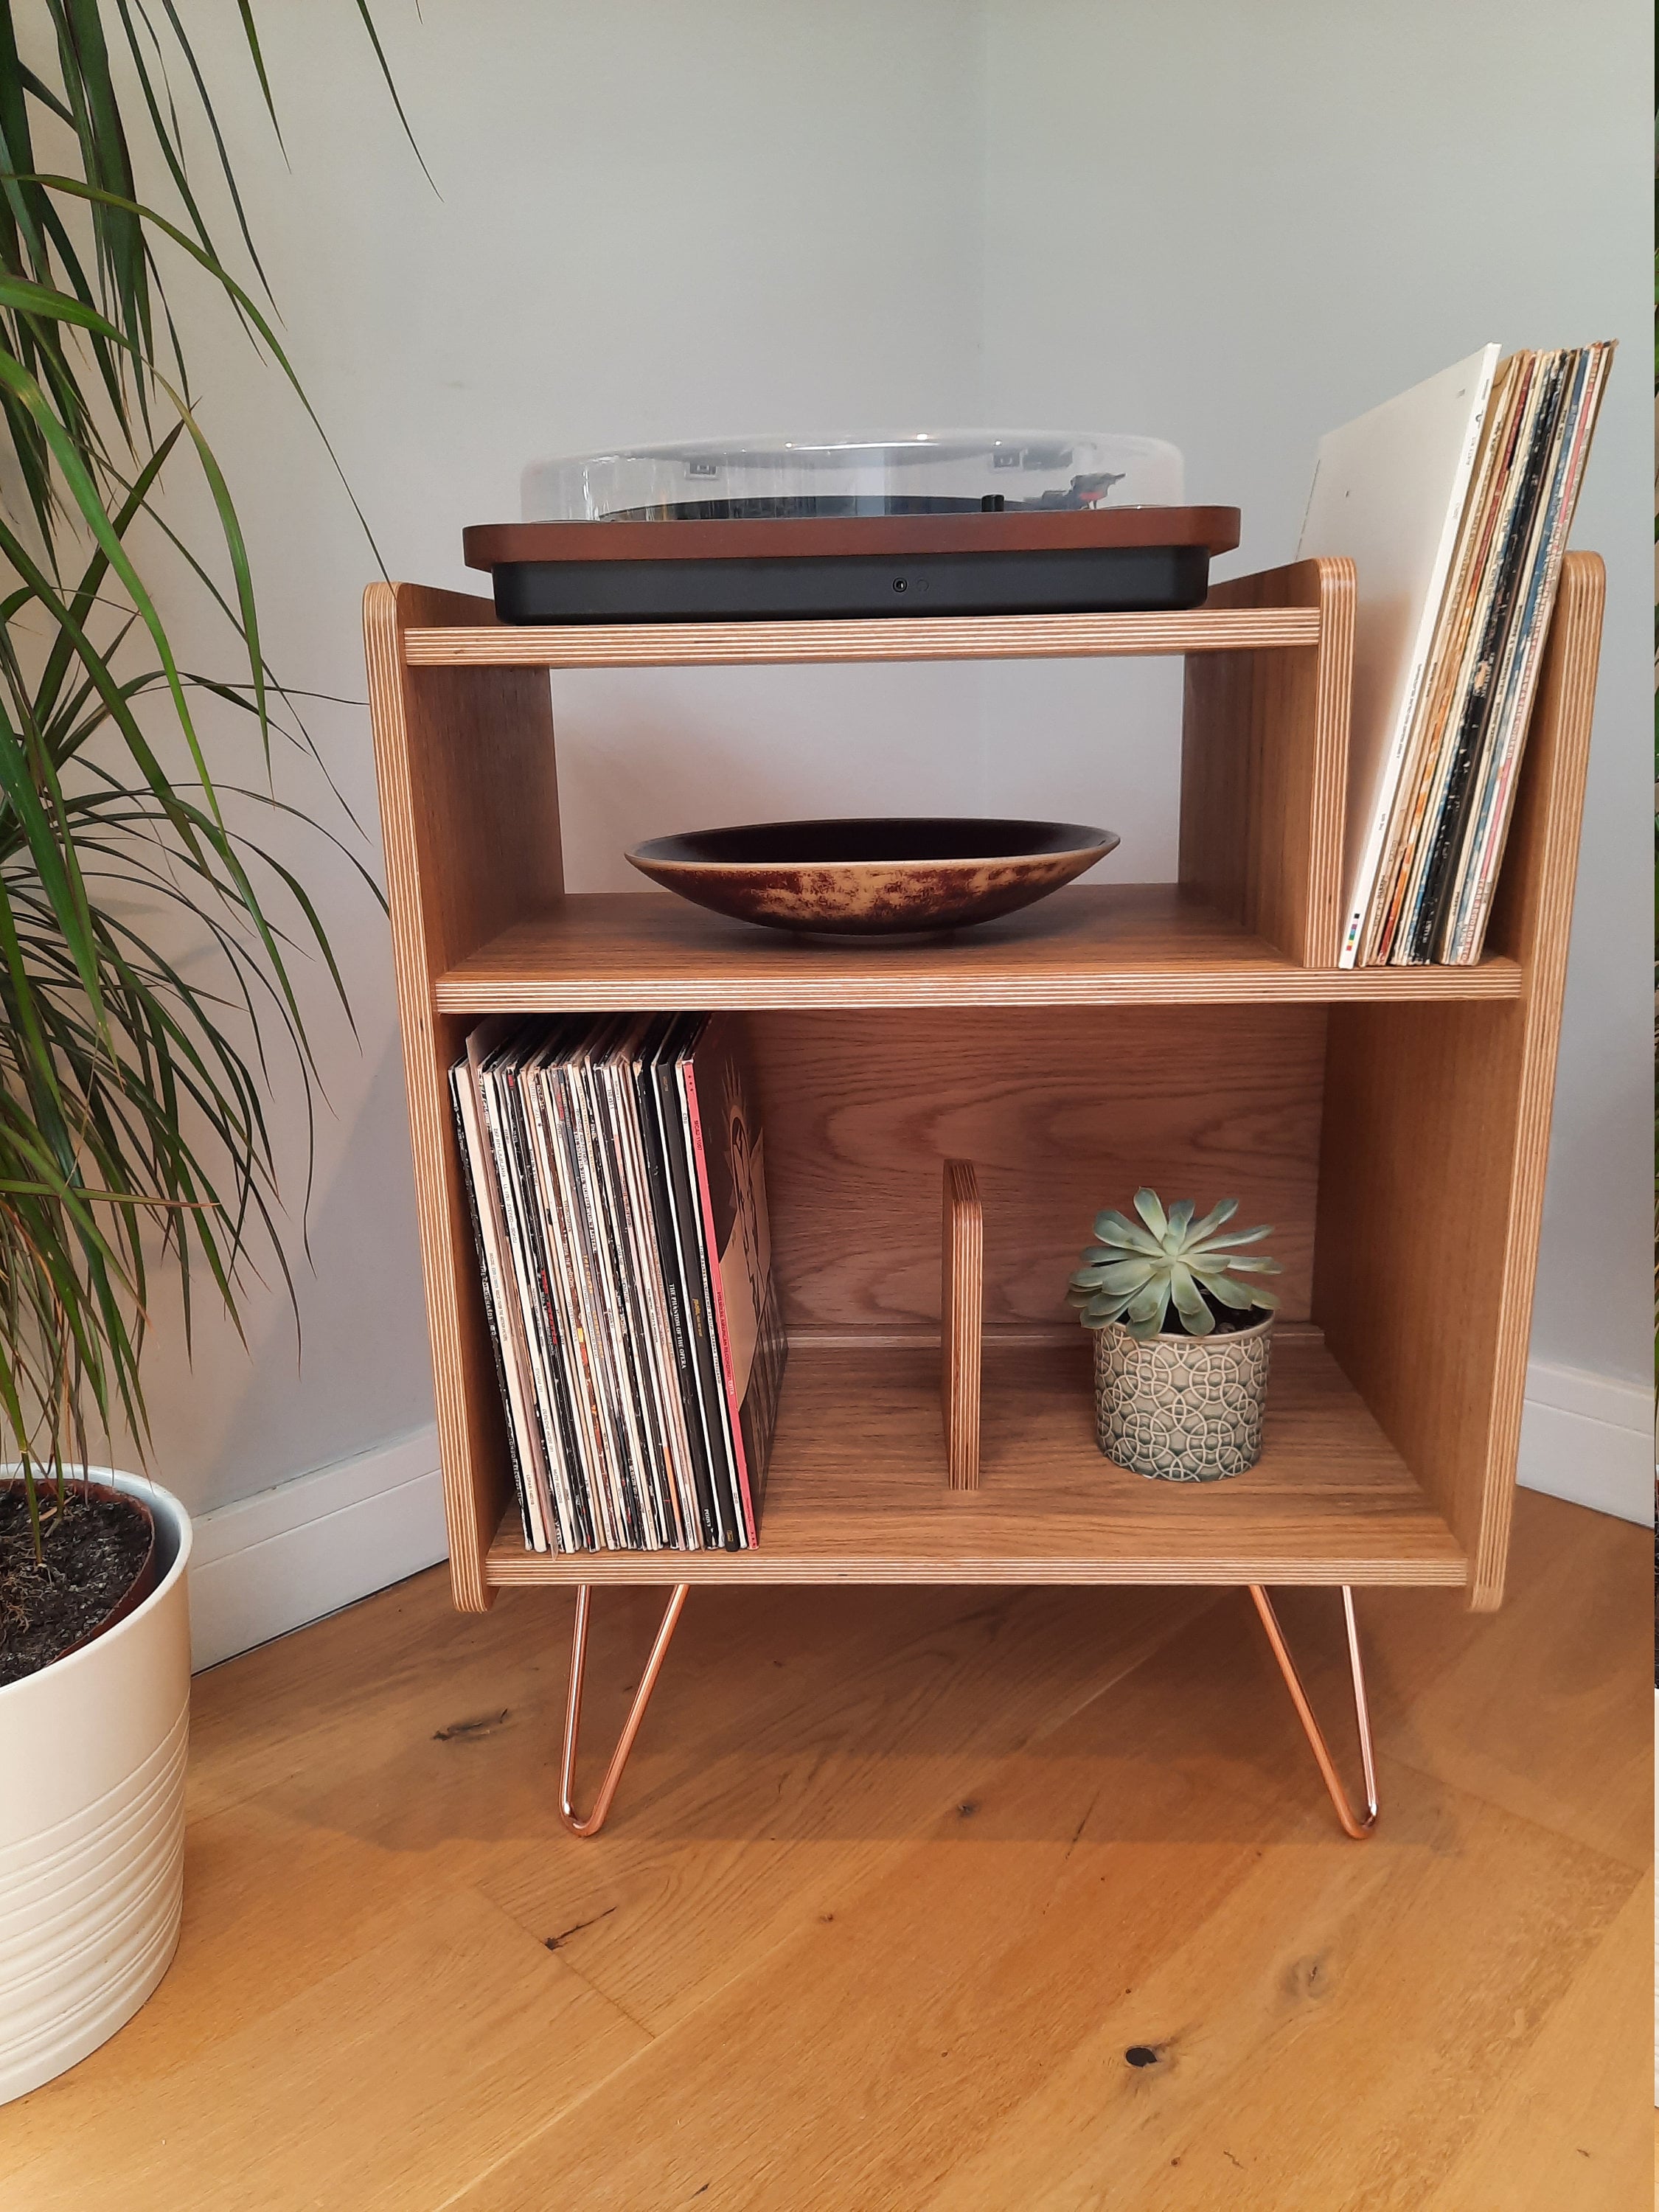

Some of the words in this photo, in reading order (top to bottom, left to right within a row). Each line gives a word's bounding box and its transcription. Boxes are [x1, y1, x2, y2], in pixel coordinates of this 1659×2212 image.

[670, 1296, 681, 1326] PHANTOM
[678, 1348, 686, 1368] OPERA
[720, 1318, 728, 1346] AMERICAN
